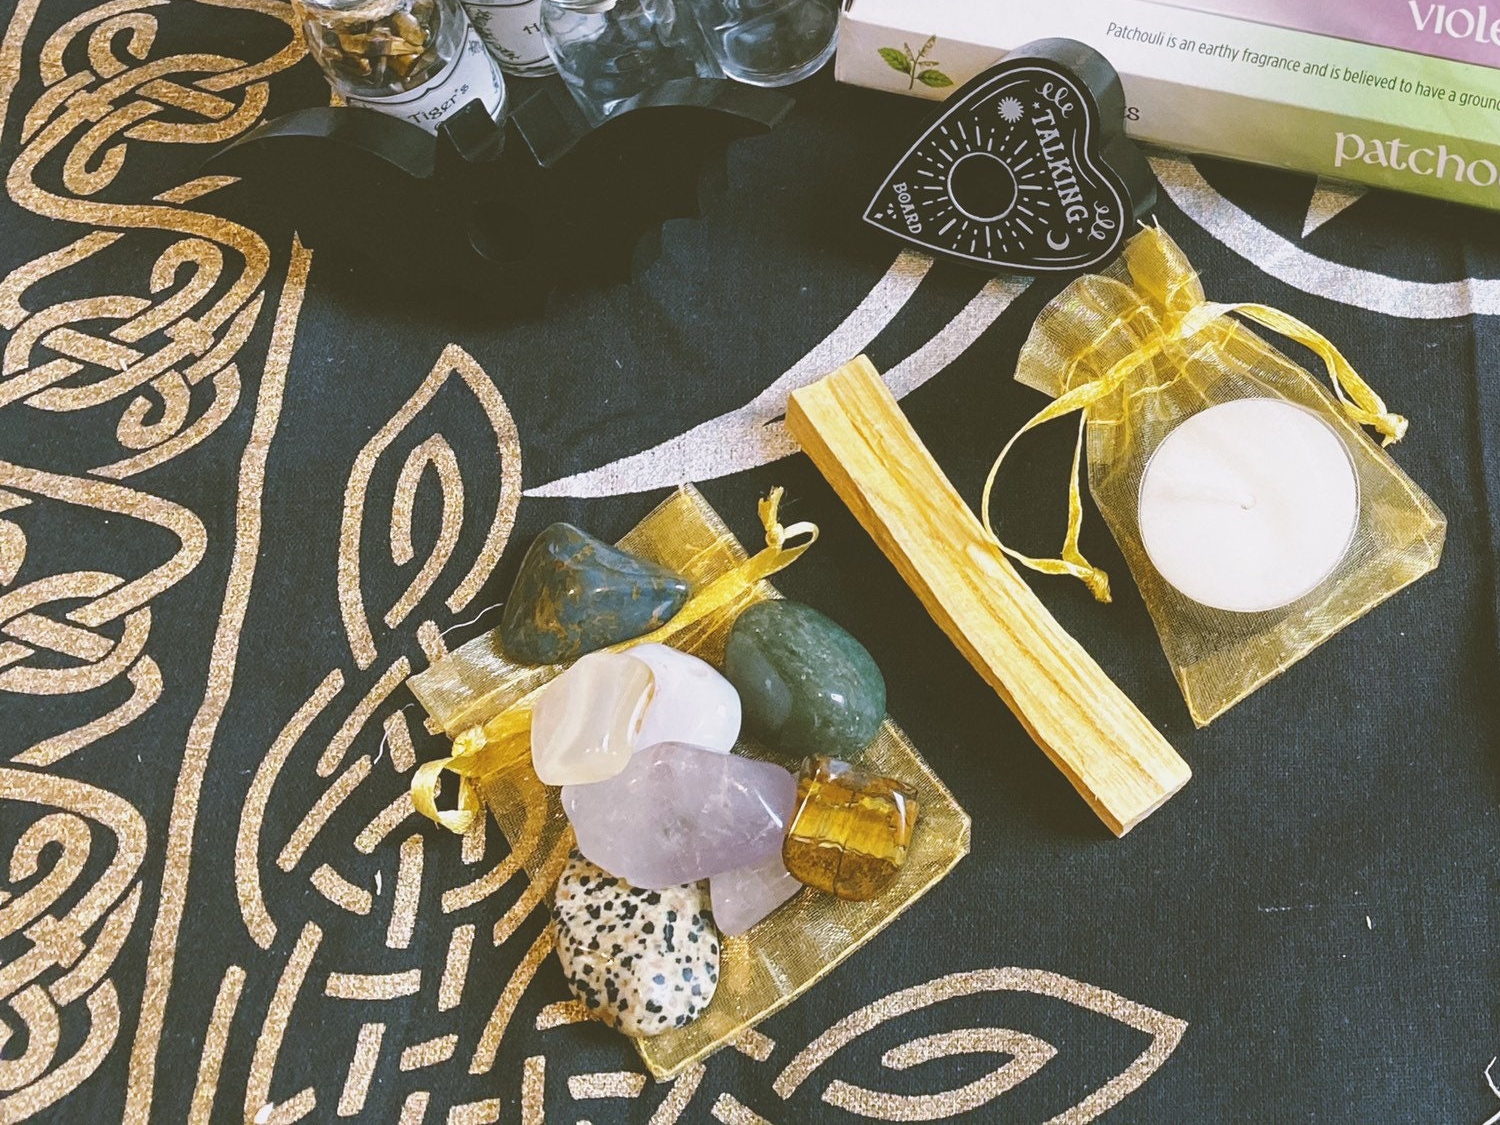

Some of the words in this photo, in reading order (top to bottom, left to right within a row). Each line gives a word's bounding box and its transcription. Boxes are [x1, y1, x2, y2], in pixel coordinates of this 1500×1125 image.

[1107, 22, 1164, 45] Patchouli
[1198, 43, 1240, 62] earthy
[1242, 48, 1300, 72] fragrance
[1303, 63, 1329, 77] and
[1343, 67, 1397, 90] believed
[1415, 81, 1445, 100] have
[408, 84, 470, 123] Tiger's
[1031, 108, 1089, 225] TALKING
[893, 181, 923, 235] BOARD
